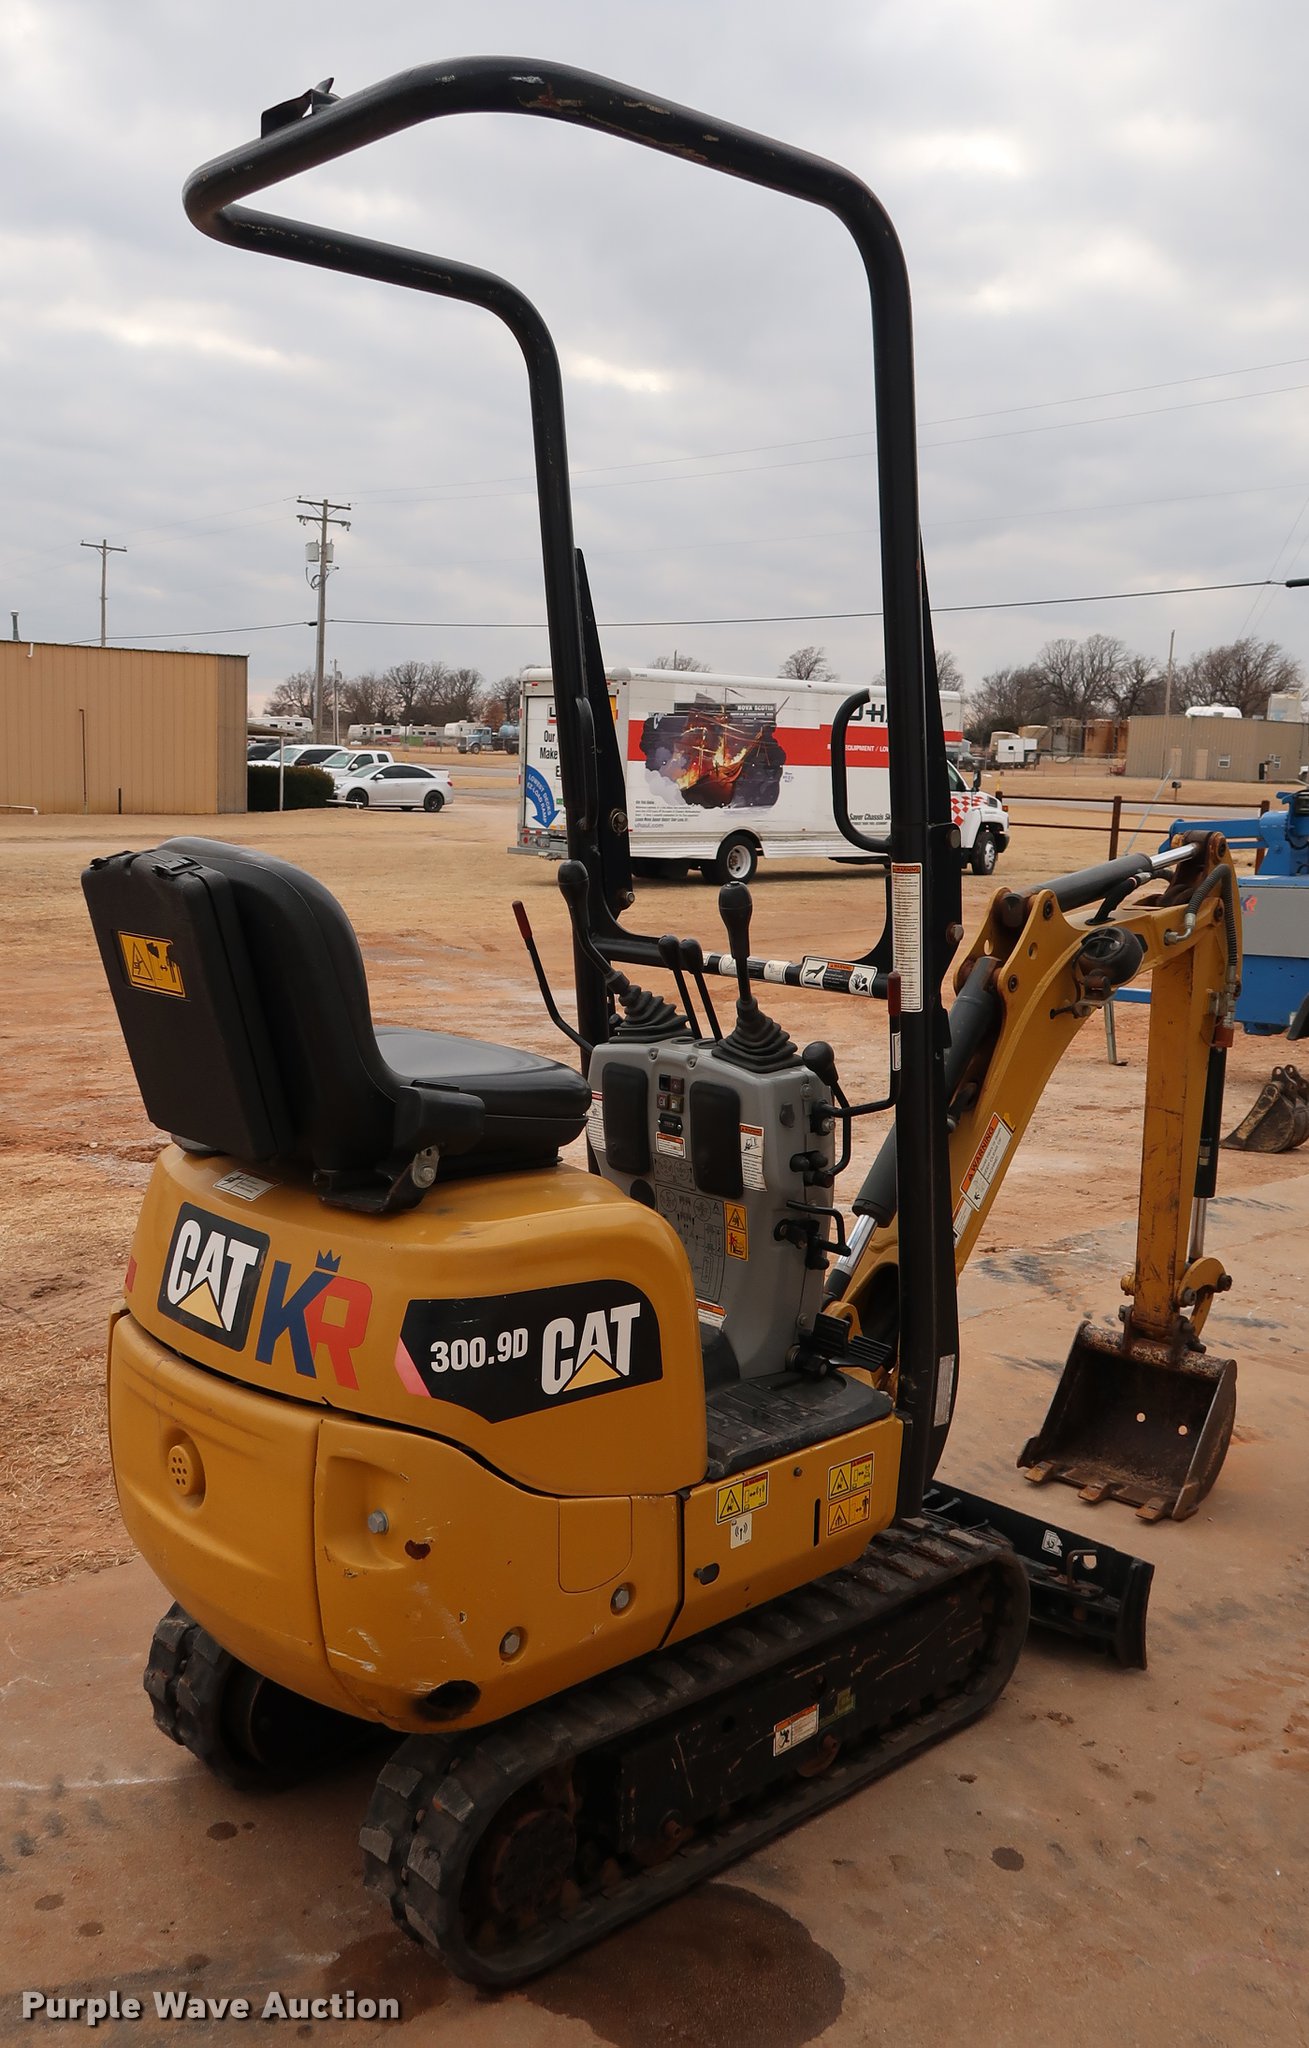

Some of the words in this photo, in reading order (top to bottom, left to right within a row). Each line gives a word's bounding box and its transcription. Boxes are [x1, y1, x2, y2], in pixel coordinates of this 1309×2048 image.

[543, 730, 556, 743] Our
[845, 744, 875, 752] EQUIPMENT
[539, 747, 558, 760] Make
[864, 812, 884, 821] Chassis
[971, 1125, 995, 1173] WARNING
[167, 1219, 260, 1333] CAT
[255, 1259, 373, 1391] KR
[430, 1328, 529, 1373] 300.9D
[541, 1302, 641, 1395] CAT
